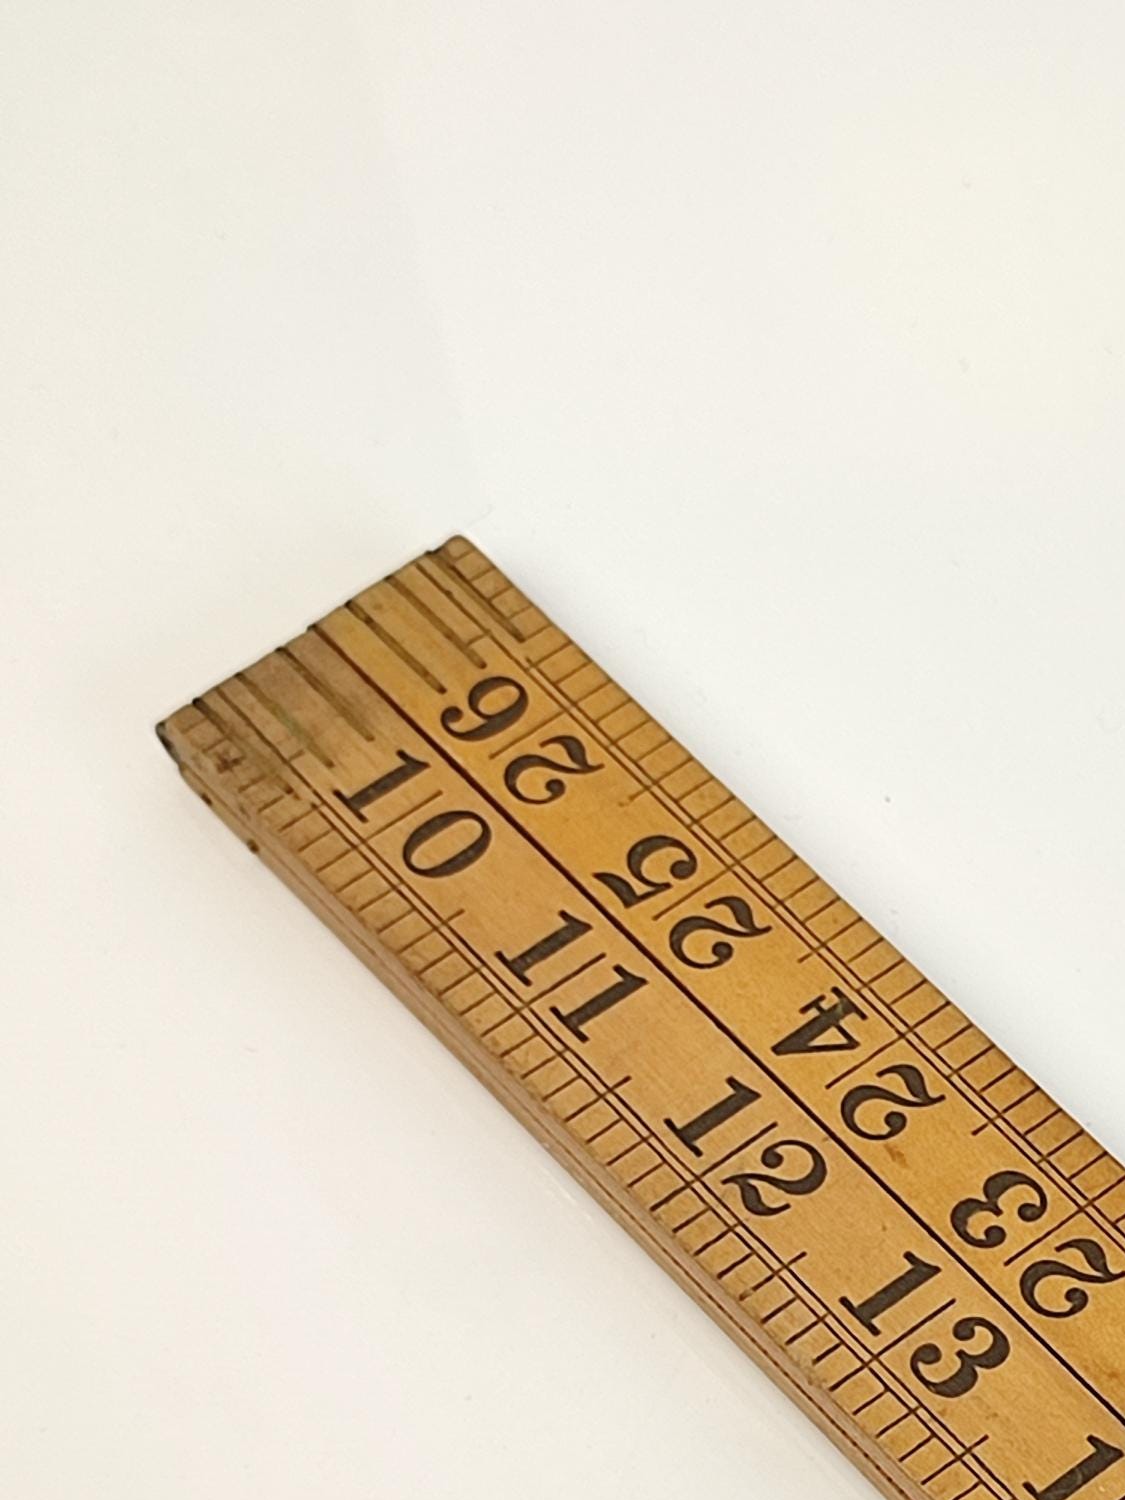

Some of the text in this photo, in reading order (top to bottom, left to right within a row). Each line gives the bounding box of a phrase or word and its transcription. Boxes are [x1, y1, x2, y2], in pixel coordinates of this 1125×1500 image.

[440, 676, 604, 804] 26
[332, 749, 492, 878] 10
[593, 834, 773, 969] 25
[494, 909, 649, 1043] 11
[770, 986, 946, 1141] 24
[663, 1076, 828, 1217] 12
[839, 1251, 1011, 1398] 13
